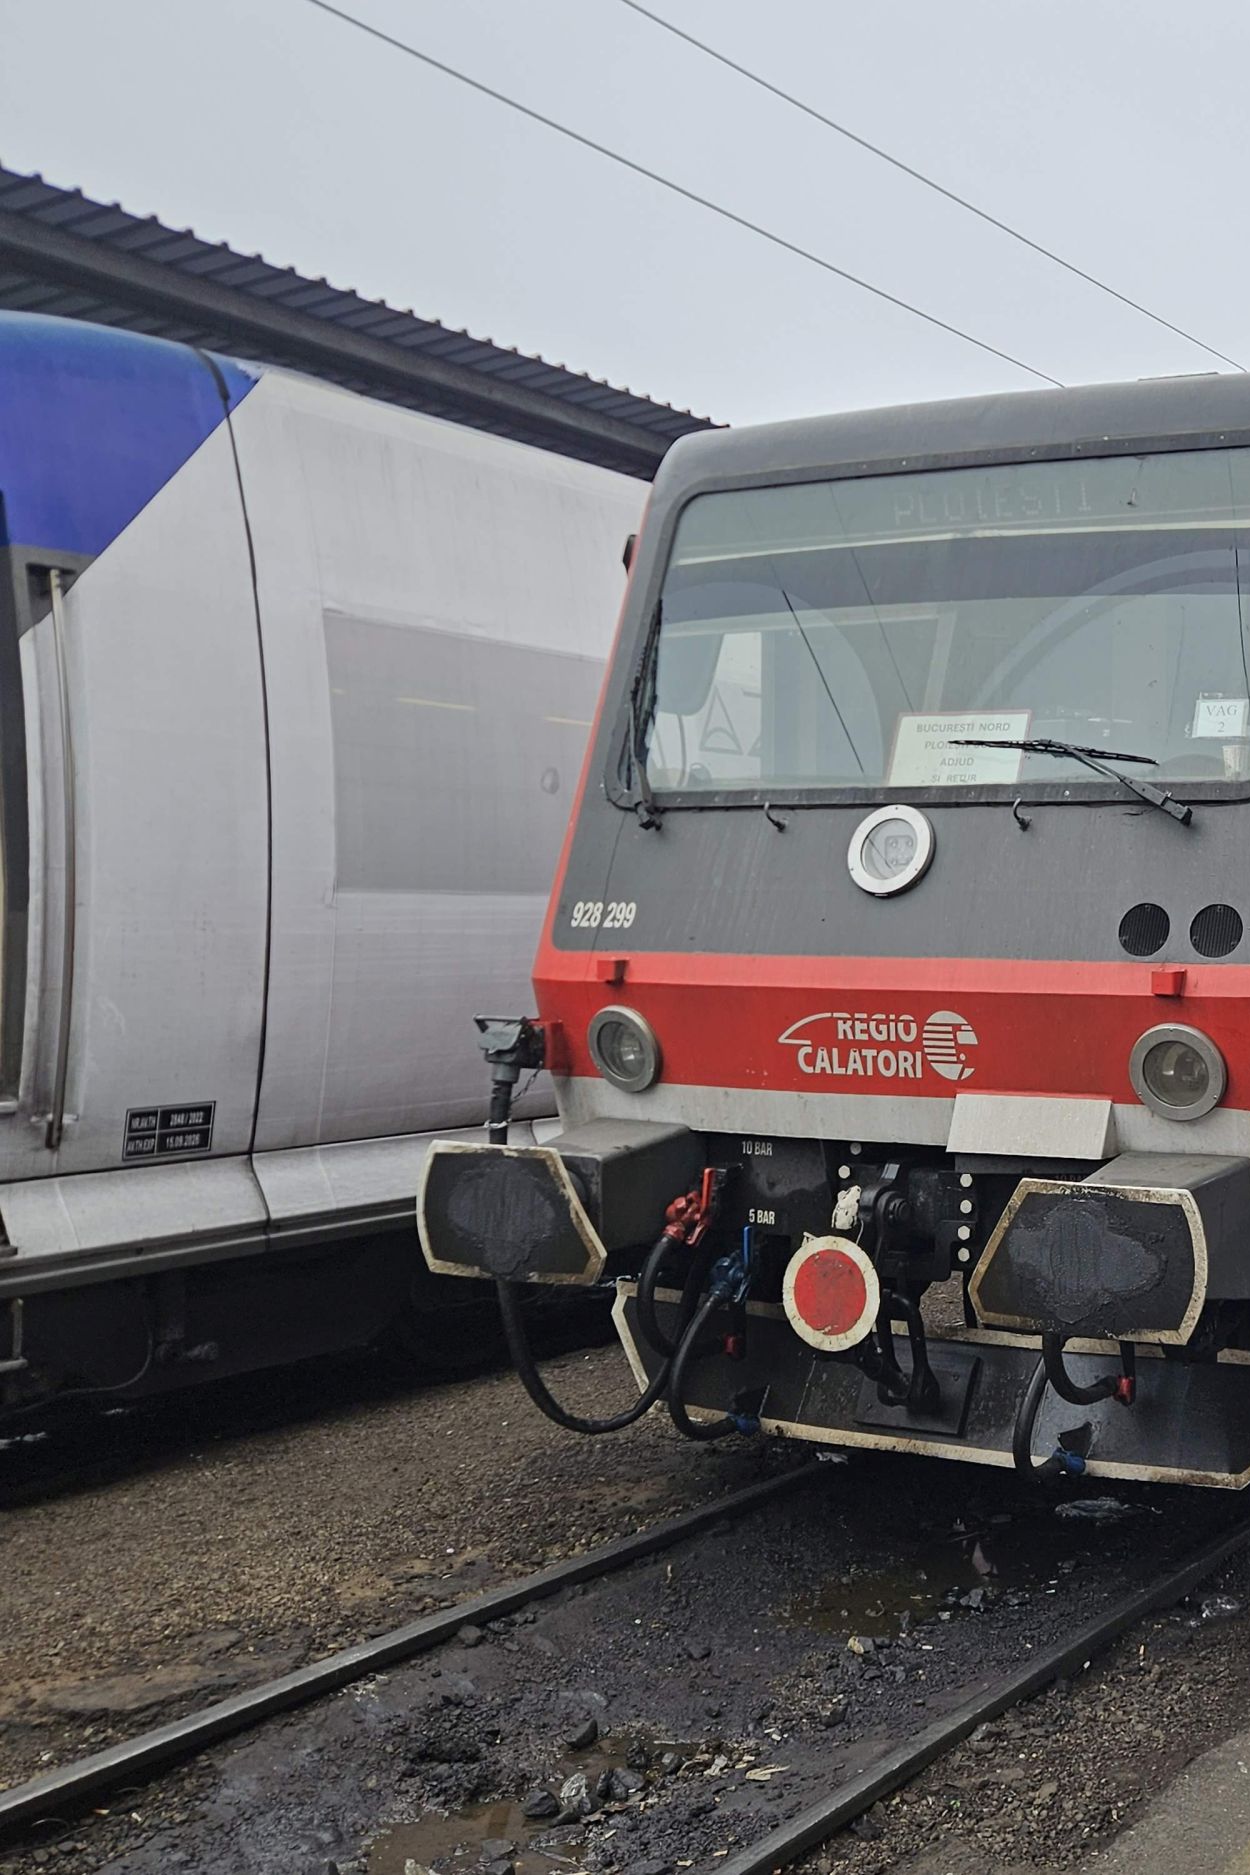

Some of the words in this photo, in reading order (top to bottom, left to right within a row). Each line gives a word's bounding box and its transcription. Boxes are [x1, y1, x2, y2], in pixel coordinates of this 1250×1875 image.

[1206, 704, 1238, 716] VAG
[979, 723, 1010, 731] NORD
[1217, 721, 1225, 732] 2
[571, 901, 604, 928] 928
[602, 902, 637, 929] 299
[742, 1141, 753, 1155] 10
[754, 1142, 773, 1156] BAR
[748, 1208, 756, 1223] 5
[756, 1209, 775, 1225] BAR
